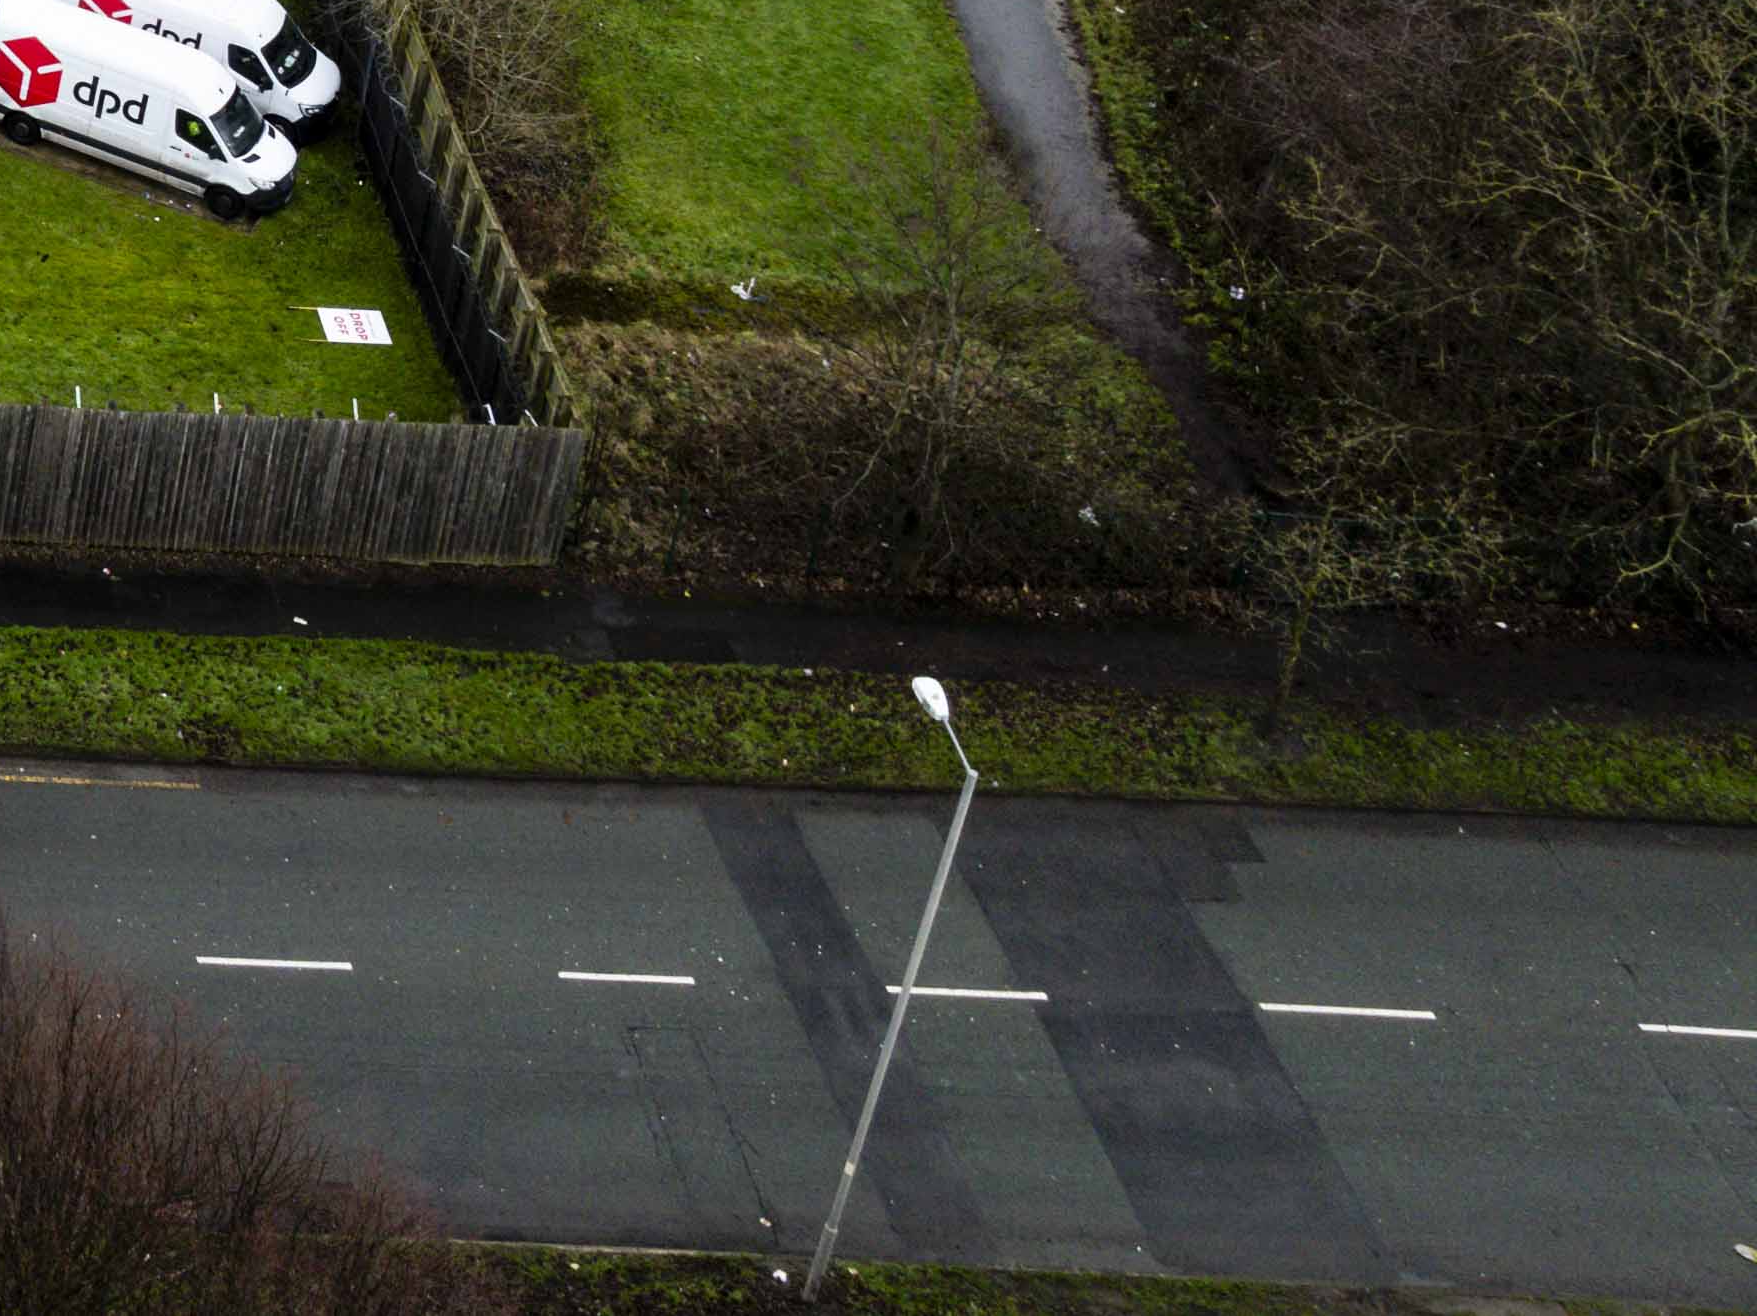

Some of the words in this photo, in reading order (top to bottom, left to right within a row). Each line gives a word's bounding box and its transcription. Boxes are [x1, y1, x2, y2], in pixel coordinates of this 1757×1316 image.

[73, 76, 149, 125] dpd
[333, 315, 349, 336] OFF
[349, 312, 369, 341] DROP
